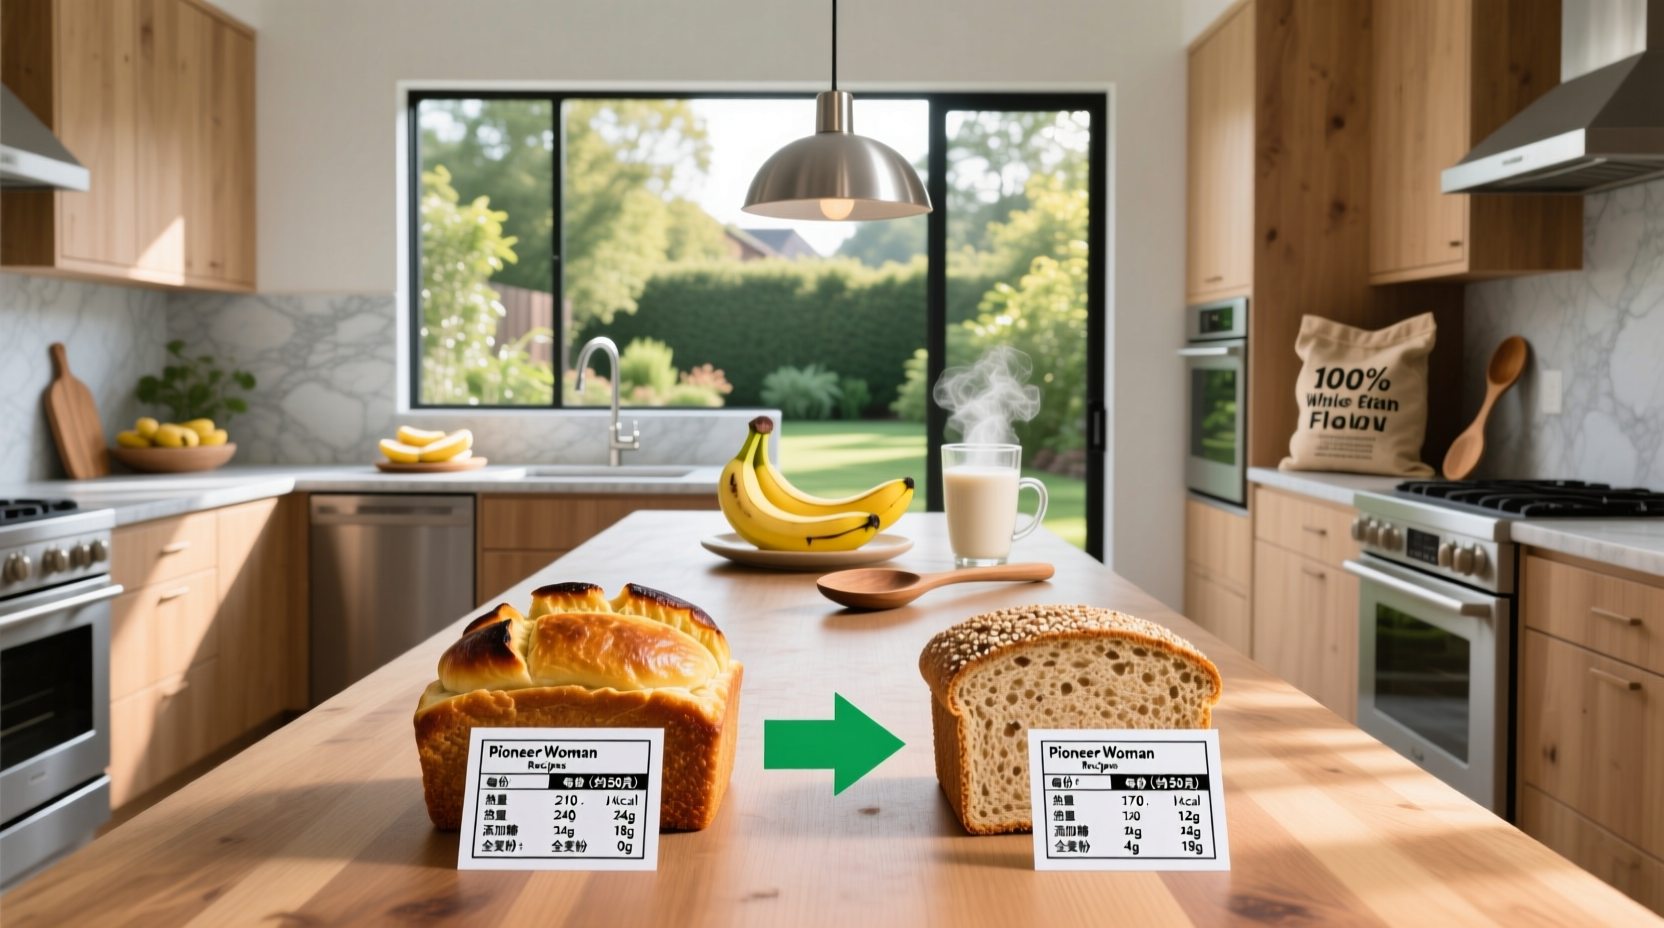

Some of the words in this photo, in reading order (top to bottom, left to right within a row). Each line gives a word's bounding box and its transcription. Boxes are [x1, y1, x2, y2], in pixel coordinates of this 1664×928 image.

[1314, 366, 1391, 392] 100%
[489, 745, 542, 758] Pioneer
[544, 745, 597, 758] Woman
[1049, 746, 1101, 759] Pioneer
[1103, 746, 1155, 759] Woman
[1178, 811, 1199, 824] 12g
[615, 826, 634, 839] 18g
[617, 841, 632, 854] 0g
[1124, 840, 1139, 854] 4g
